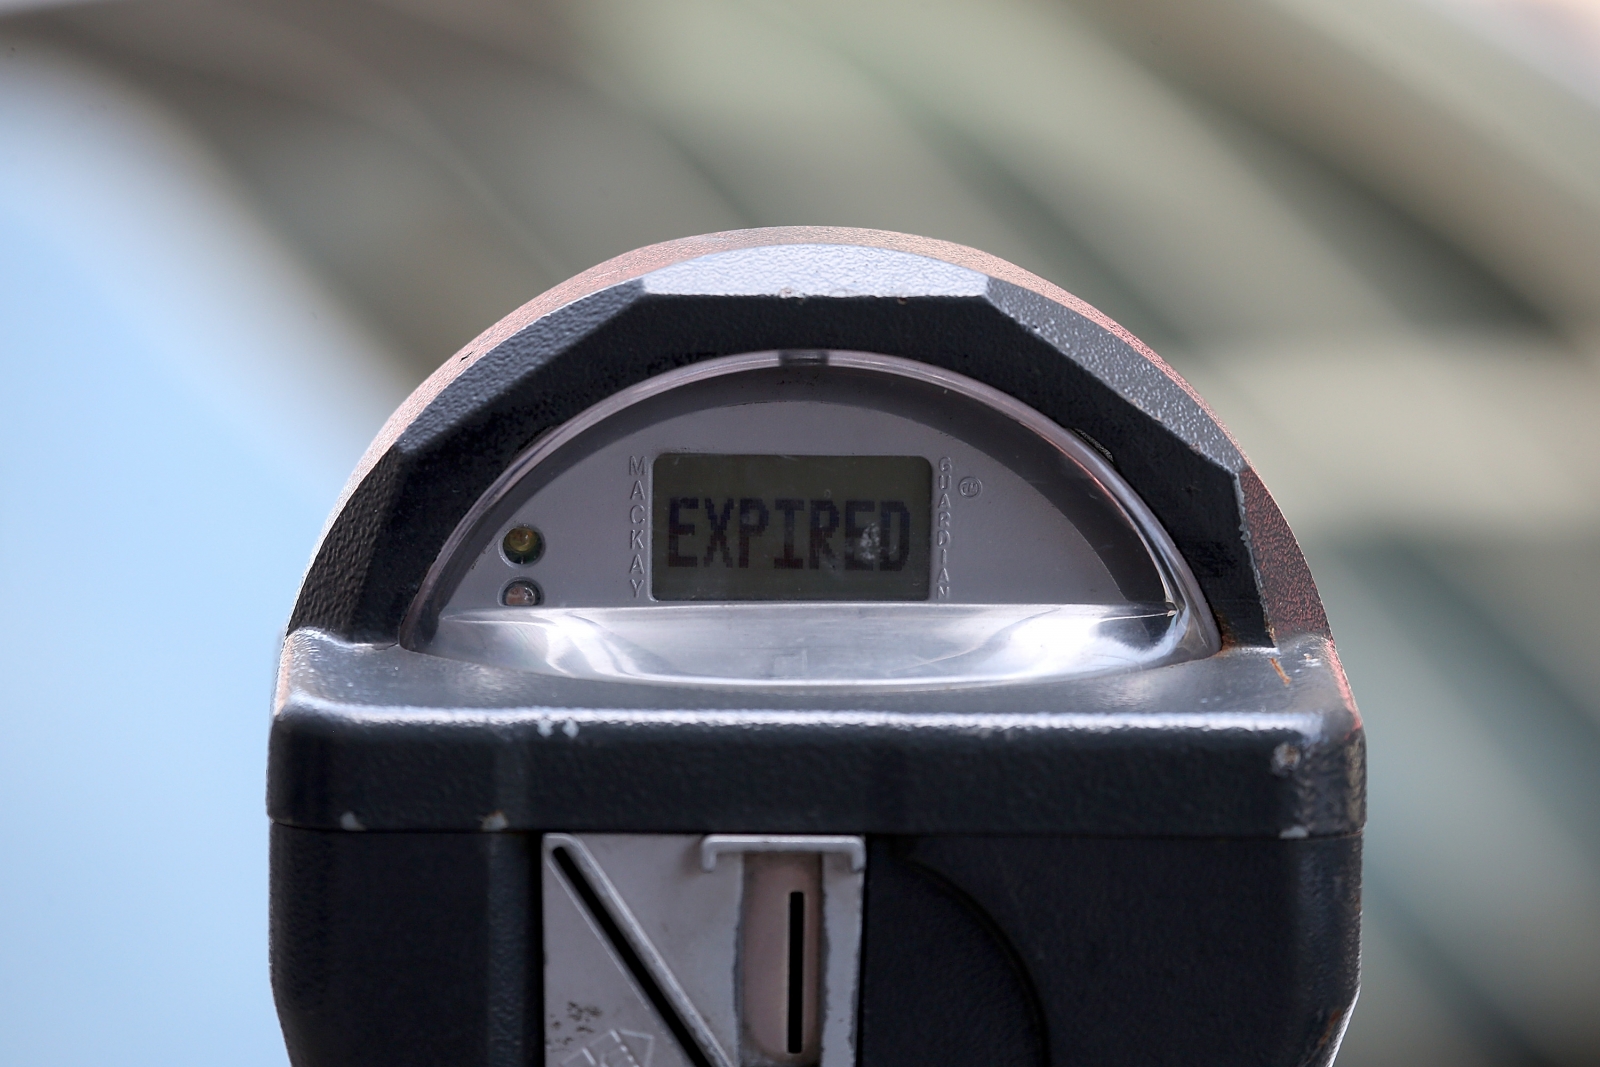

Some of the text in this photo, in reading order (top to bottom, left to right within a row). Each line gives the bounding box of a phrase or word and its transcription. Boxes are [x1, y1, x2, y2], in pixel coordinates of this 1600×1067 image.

[629, 456, 647, 598] MACKAY
[667, 497, 911, 571] EXPIRED
[937, 456, 952, 600] GUARDIAN
